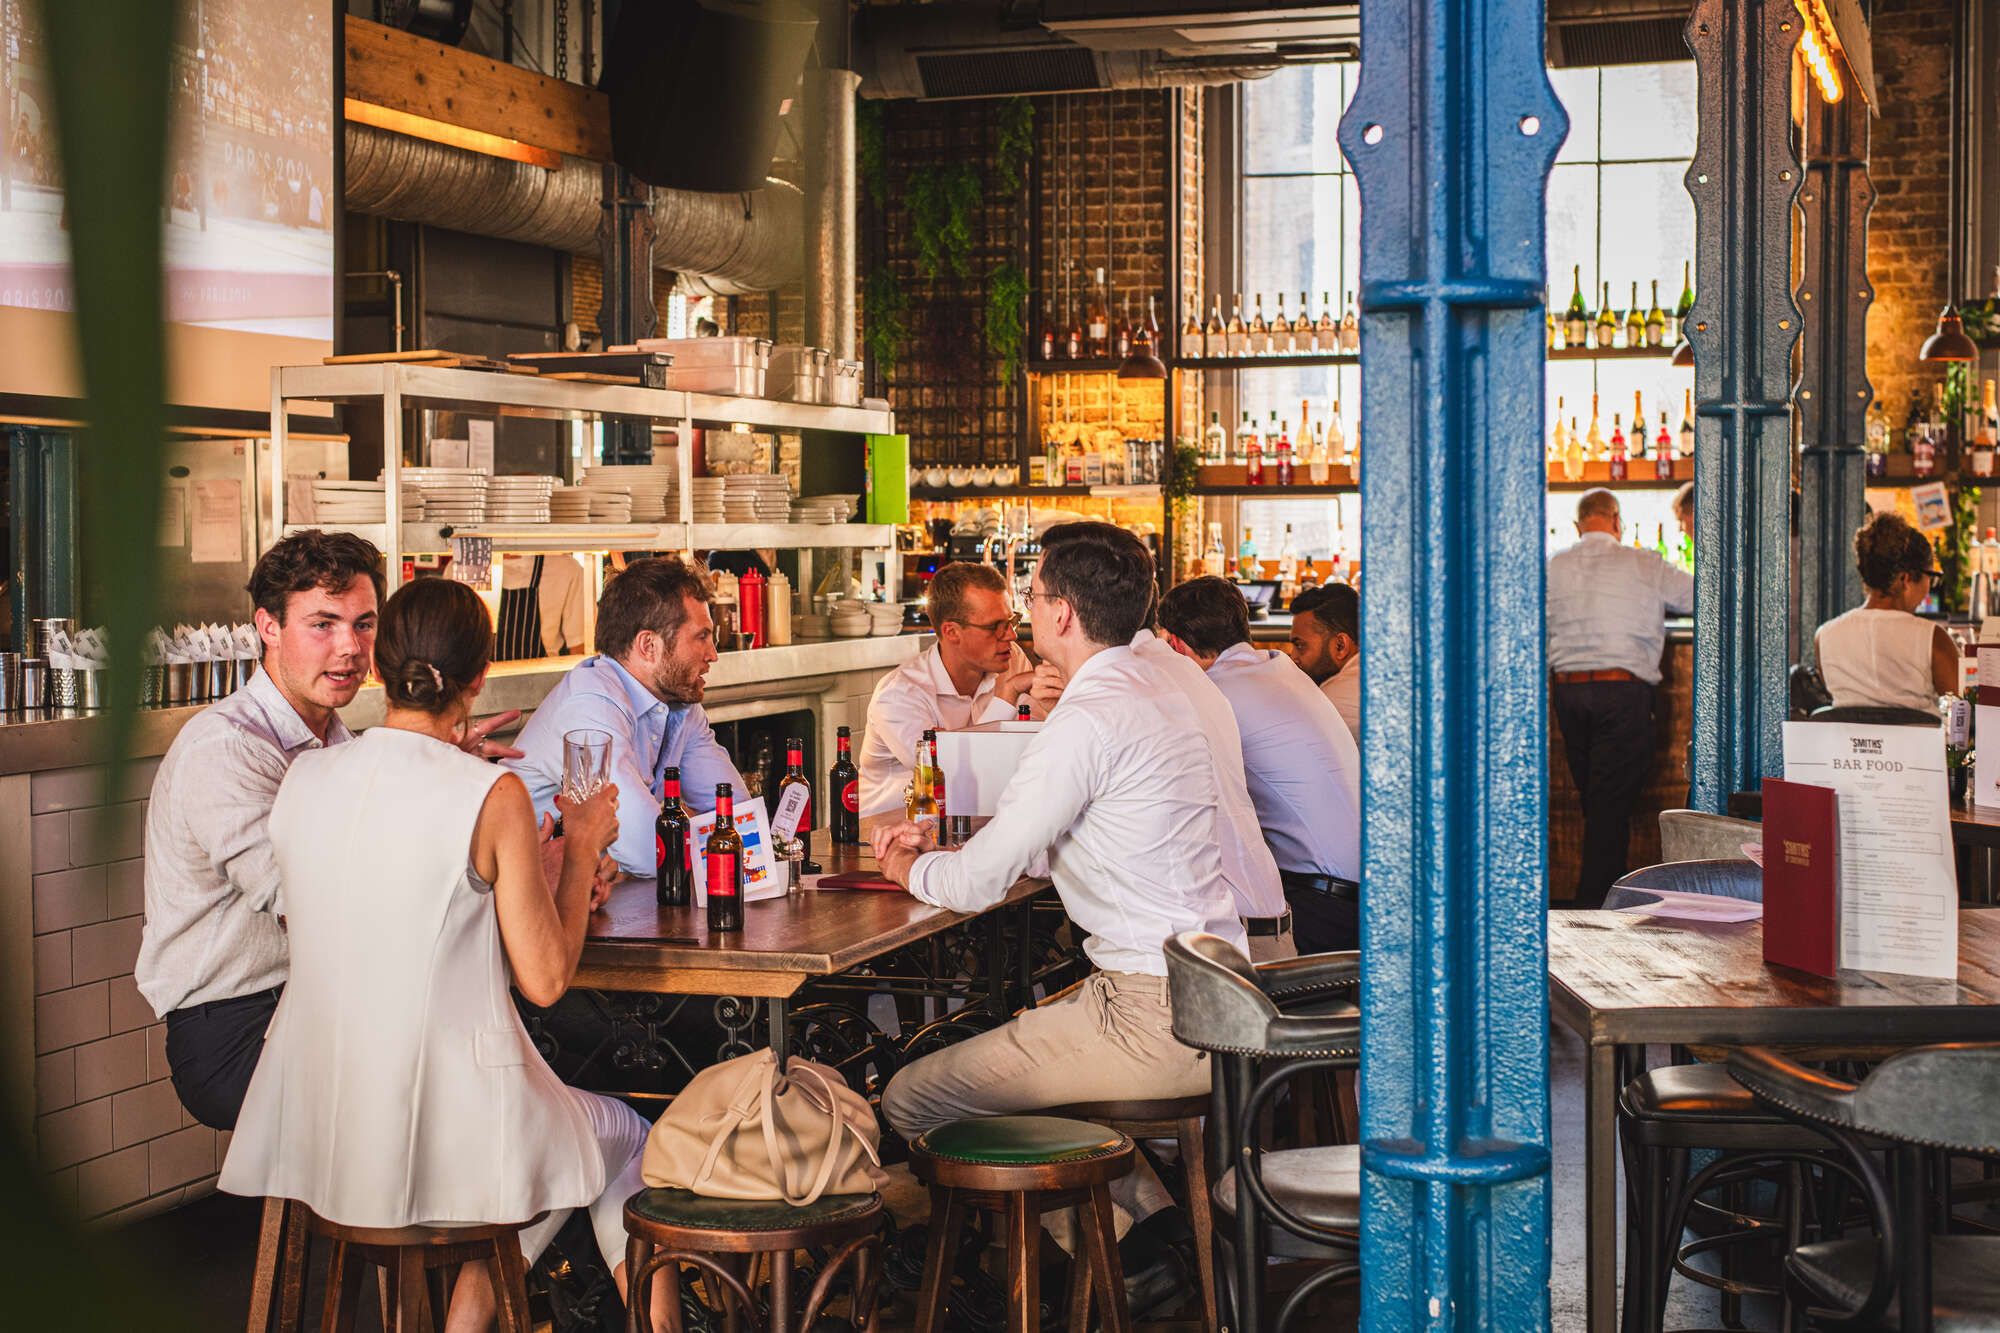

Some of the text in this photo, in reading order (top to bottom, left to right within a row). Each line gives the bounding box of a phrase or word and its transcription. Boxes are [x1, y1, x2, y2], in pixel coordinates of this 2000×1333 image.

[1833, 758, 1904, 773] BAR FOOD
[698, 812, 756, 835] SPTZ
